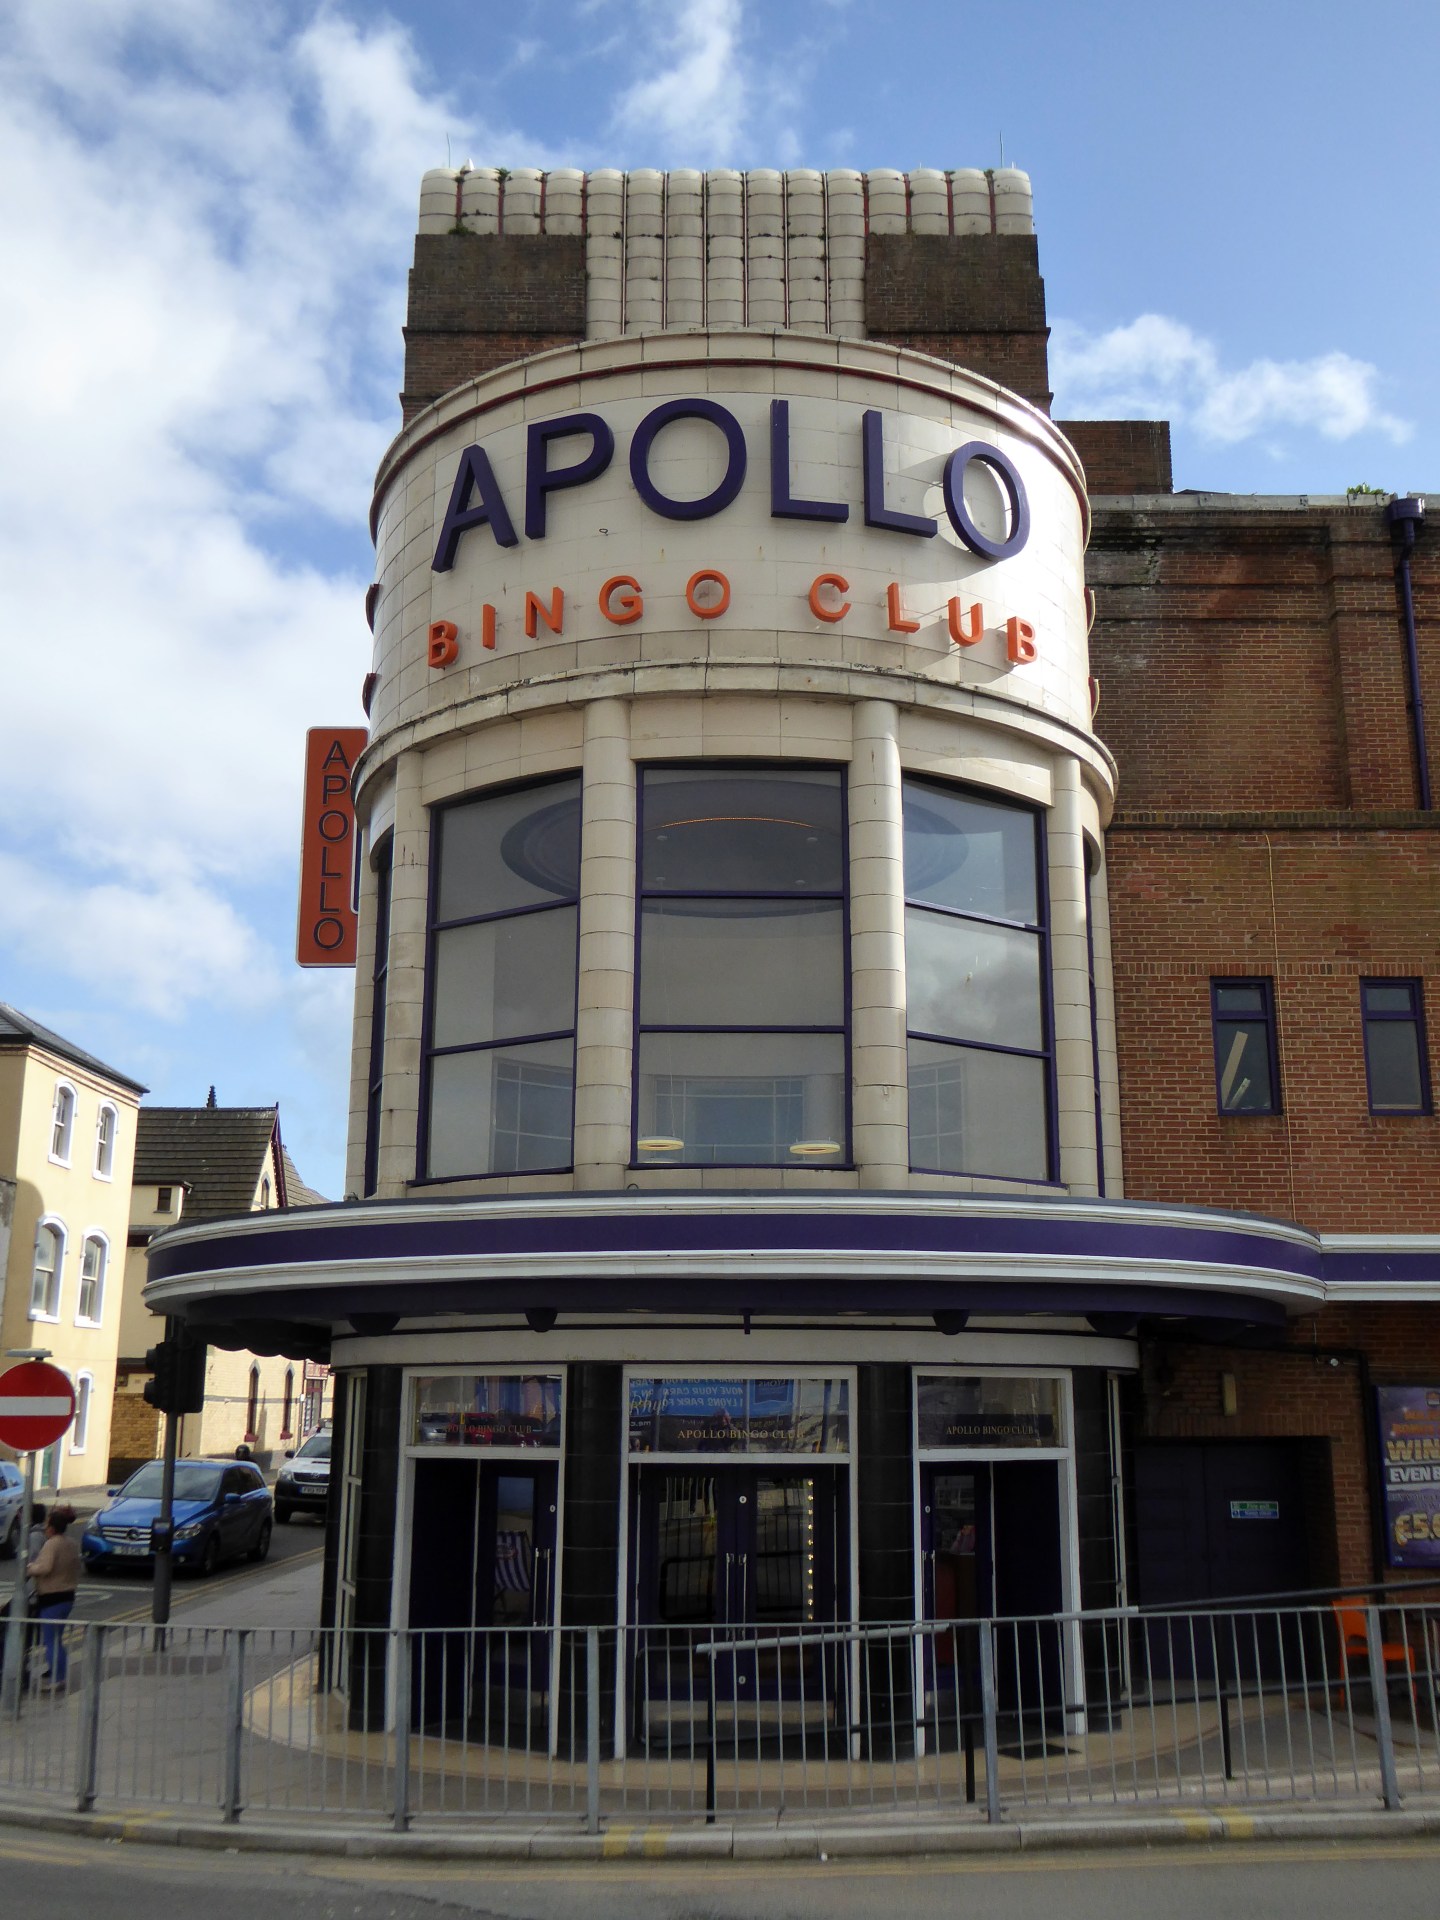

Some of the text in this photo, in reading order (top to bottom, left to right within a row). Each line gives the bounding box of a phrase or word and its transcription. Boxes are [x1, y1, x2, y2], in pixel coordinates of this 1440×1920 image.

[431, 398, 1030, 573] APOLLO
[427, 569, 1038, 669] BINGO CLUB
[313, 740, 350, 949] APOLLO
[443, 1424, 476, 1434] POLO
[508, 1424, 532, 1434] CLUB
[677, 1429, 726, 1439] APOLLO
[730, 1429, 769, 1439] BINGO
[946, 1425, 1034, 1435] APOLLO BINGO CLUB
[1390, 1466, 1431, 1482] EVEN
